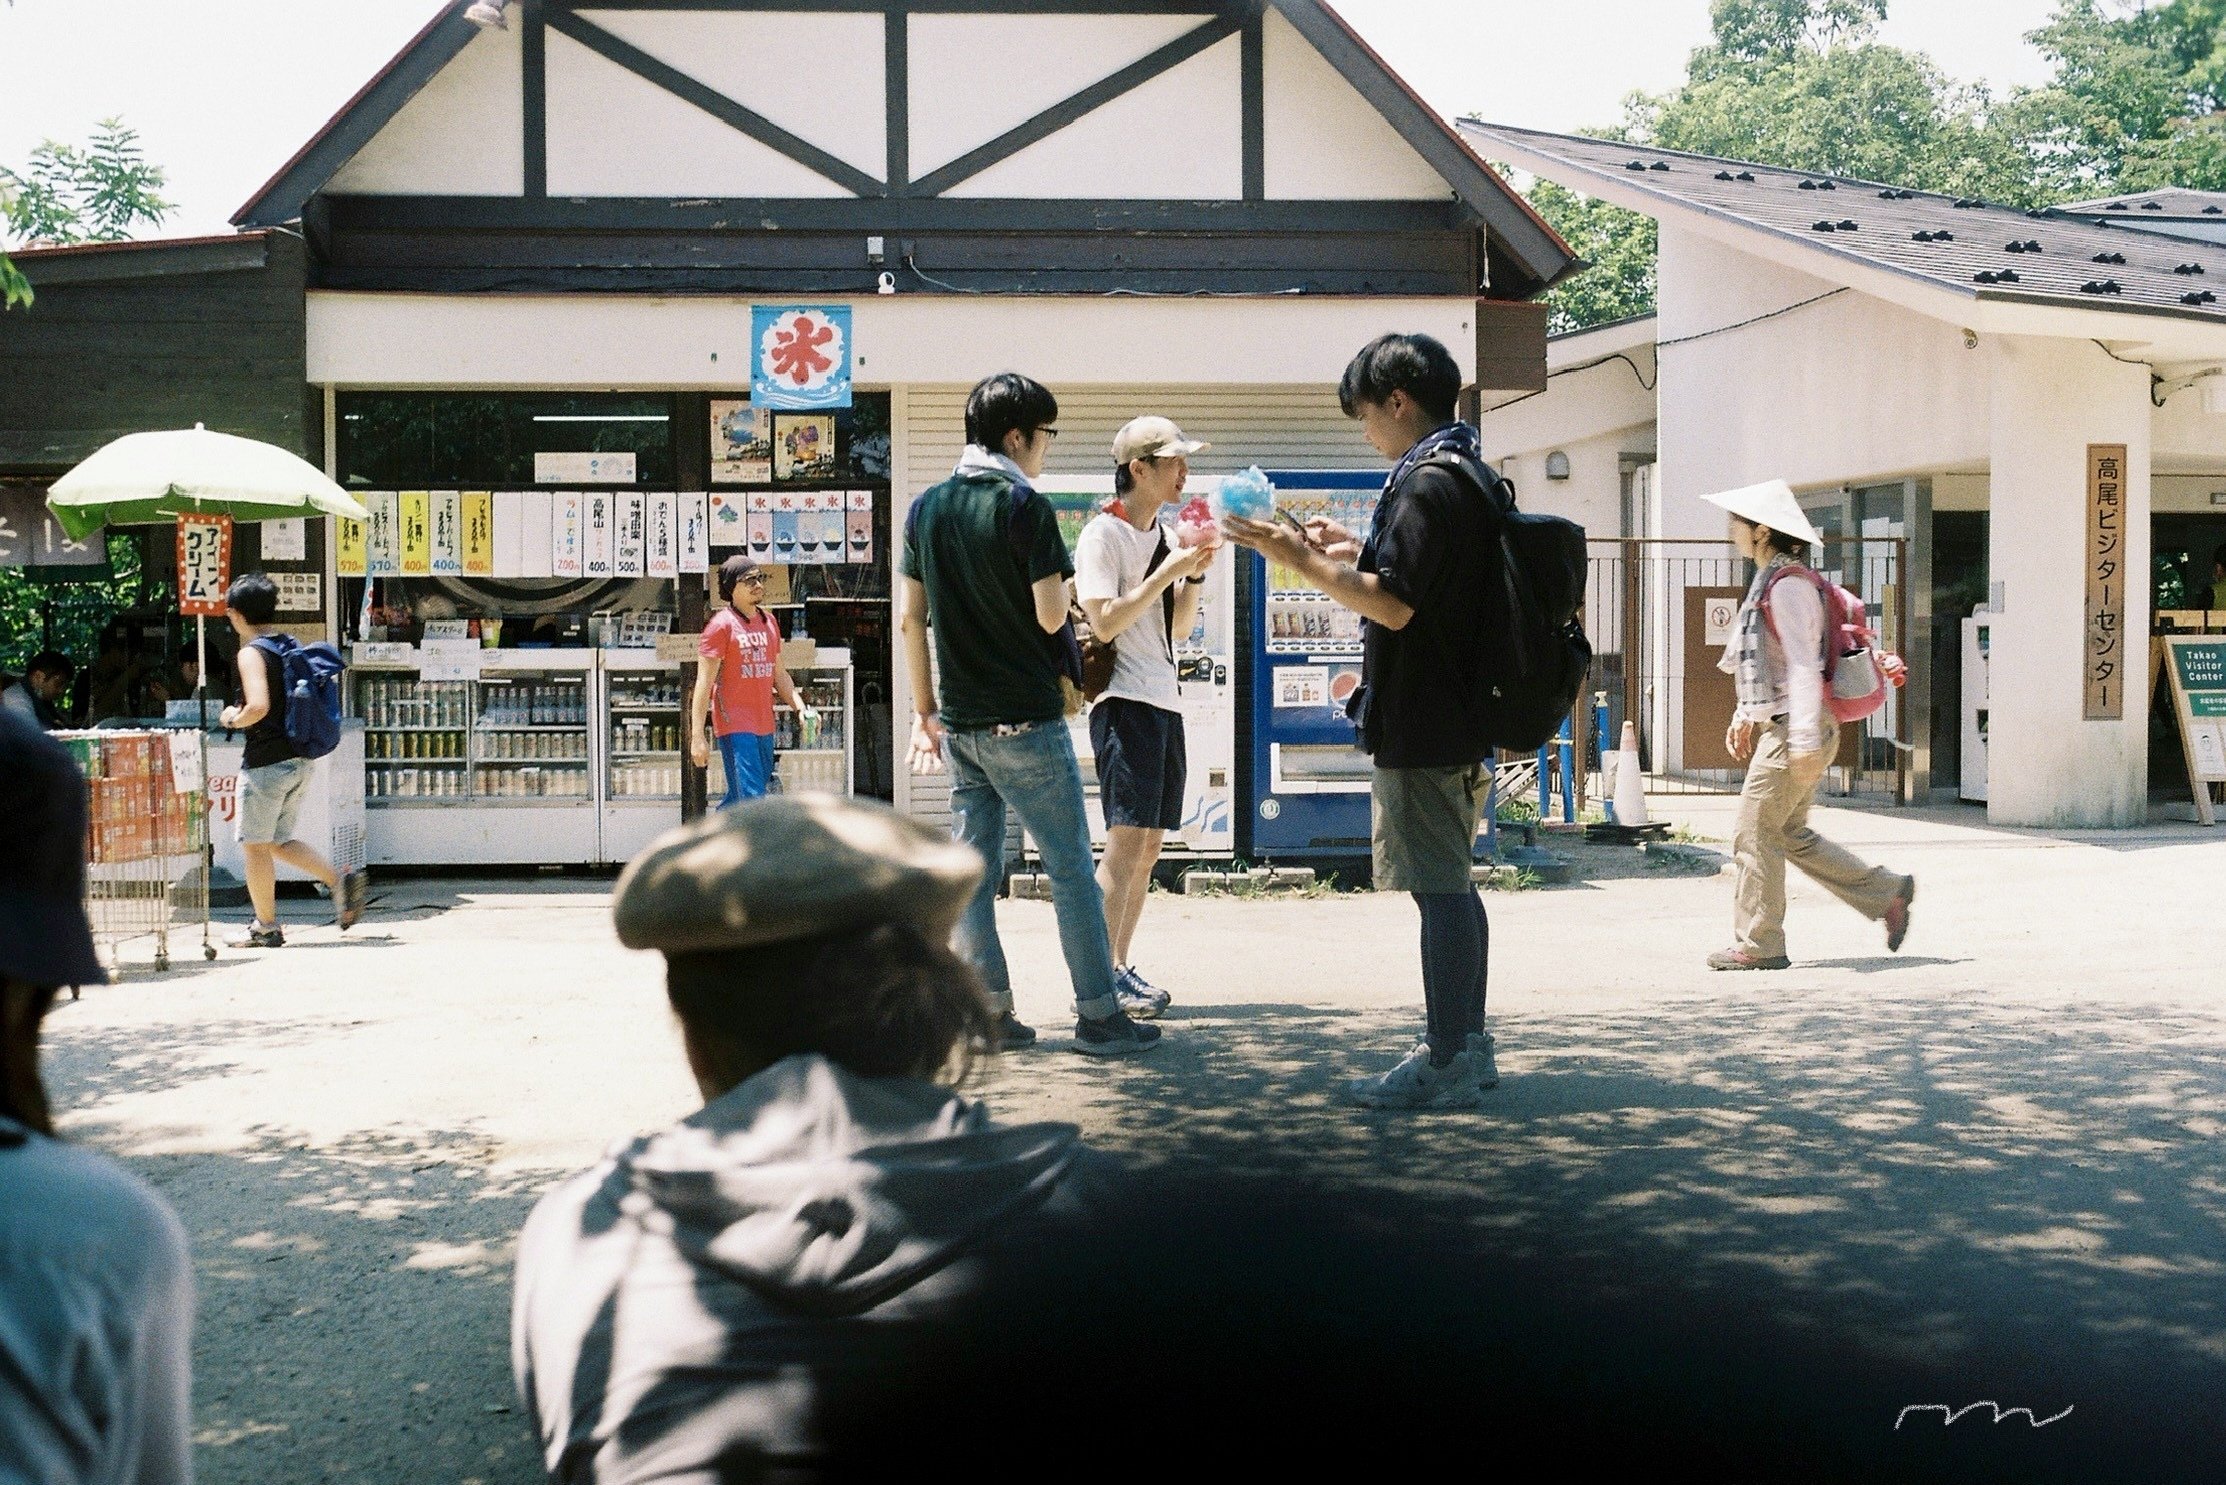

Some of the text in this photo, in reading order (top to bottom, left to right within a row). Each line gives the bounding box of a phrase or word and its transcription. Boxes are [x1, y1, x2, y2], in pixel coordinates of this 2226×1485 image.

[770, 316, 834, 386] 氷
[754, 497, 767, 509] 氷
[780, 497, 792, 509] 氷
[804, 497, 816, 509] 氷
[827, 495, 839, 508] 氷
[854, 495, 866, 508] 氷
[630, 499, 641, 539] 味噌田楽
[187, 531, 207, 597] クリーム
[2095, 457, 2119, 706] 高尾ビジターセンター
[736, 631, 768, 649] RUN
[740, 647, 767, 663] THE
[2186, 651, 2217, 660] Takao
[2185, 661, 2222, 670] Visitor
[2188, 672, 2223, 681] Center
